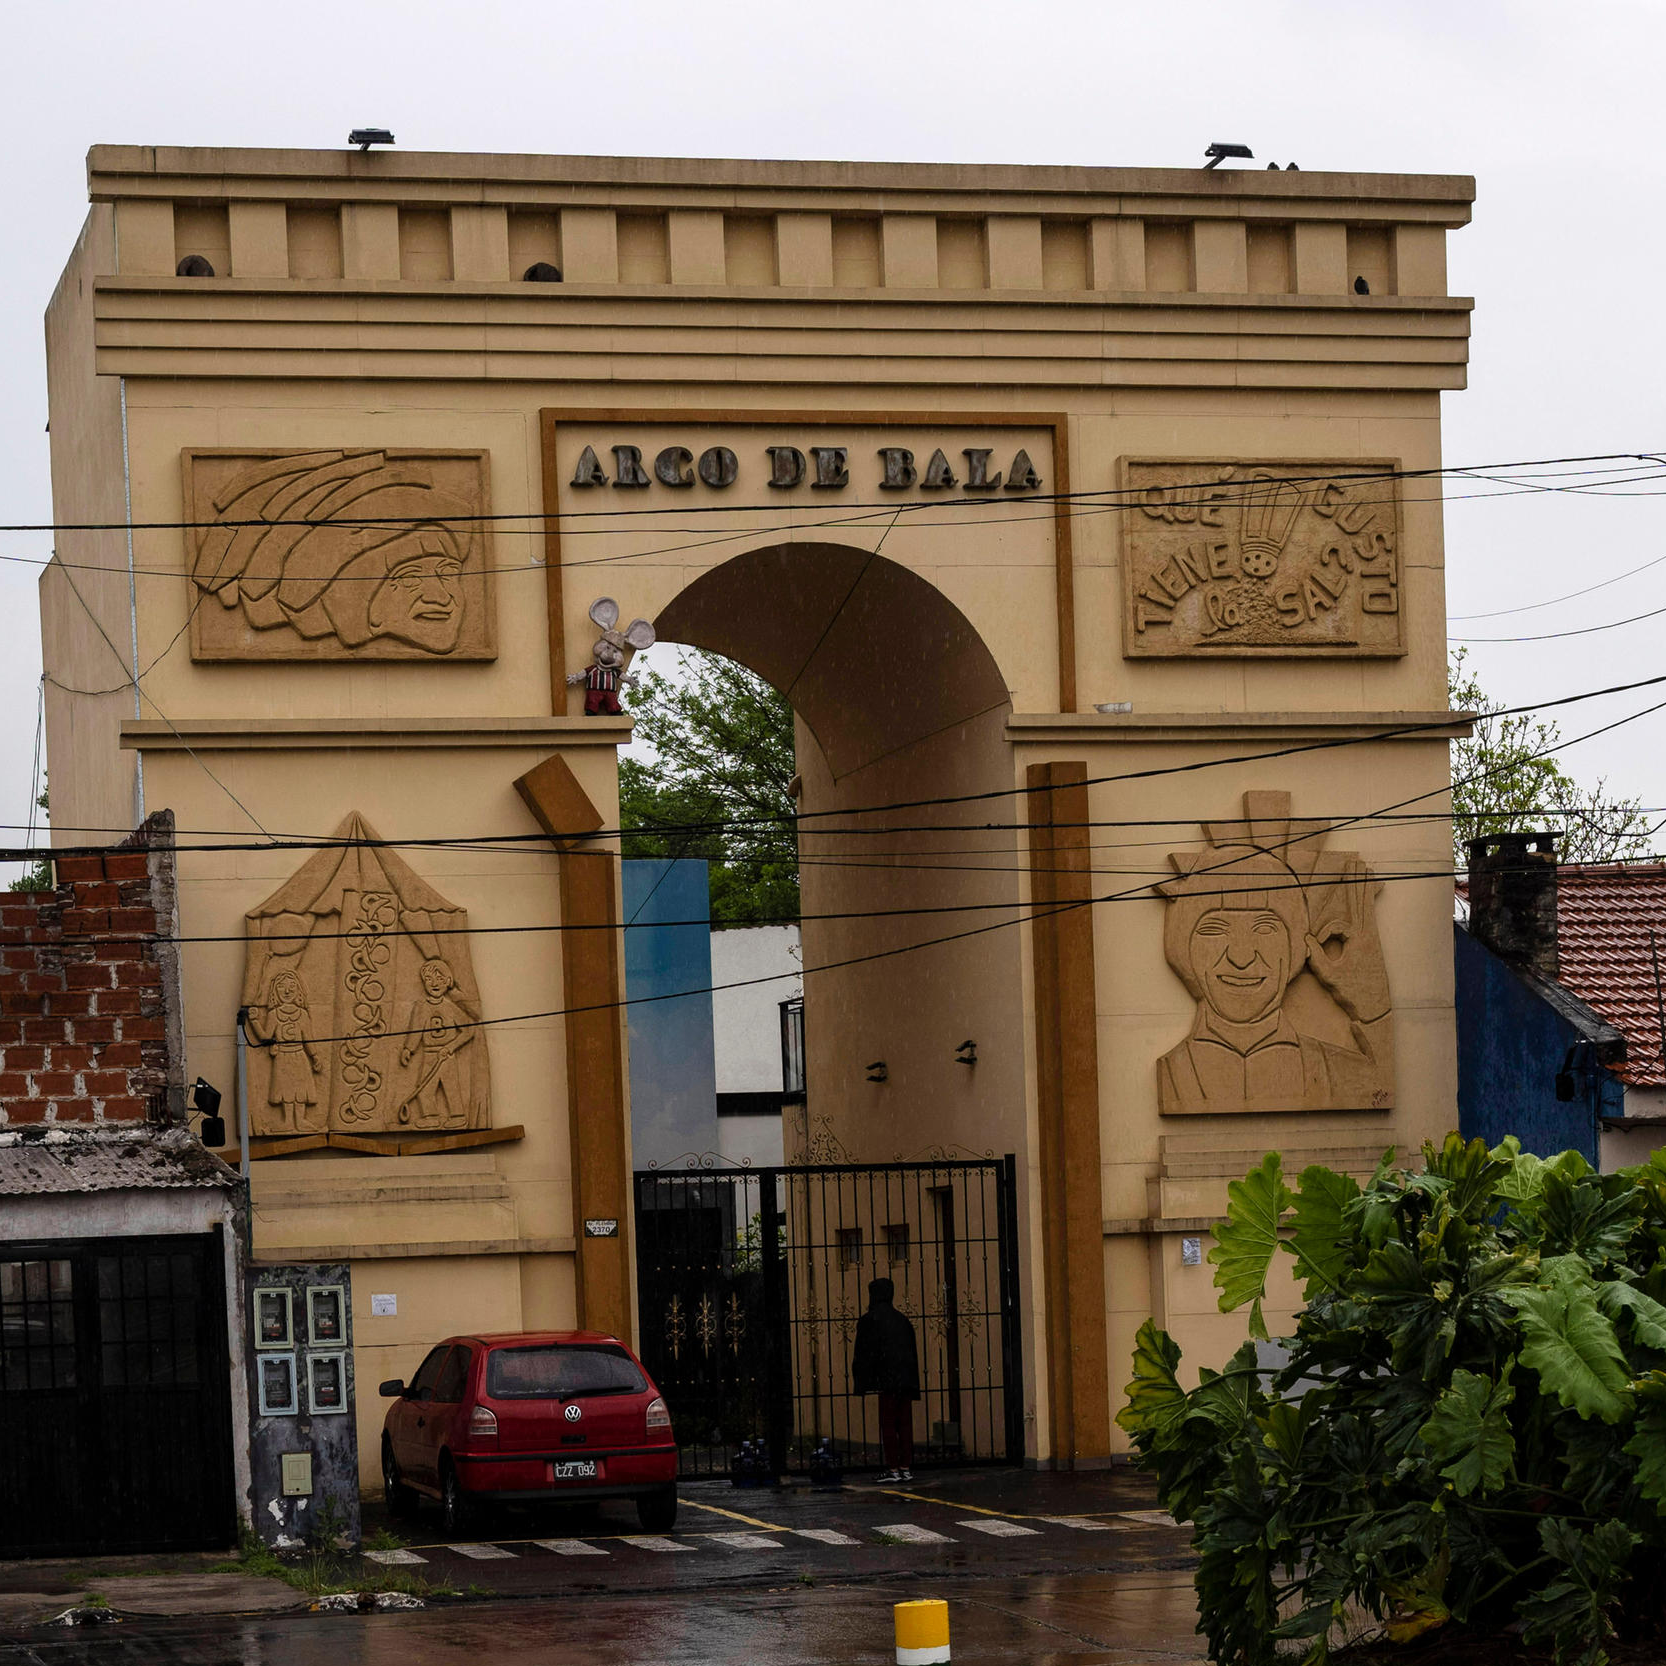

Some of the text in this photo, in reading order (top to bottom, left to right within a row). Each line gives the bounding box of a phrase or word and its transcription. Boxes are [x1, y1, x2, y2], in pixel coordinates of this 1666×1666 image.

[569, 445, 1043, 490] ARCO DE BALA
[1137, 465, 1399, 614] QUÉ GUSTO
[556, 1464, 596, 1478] CZZ 092
